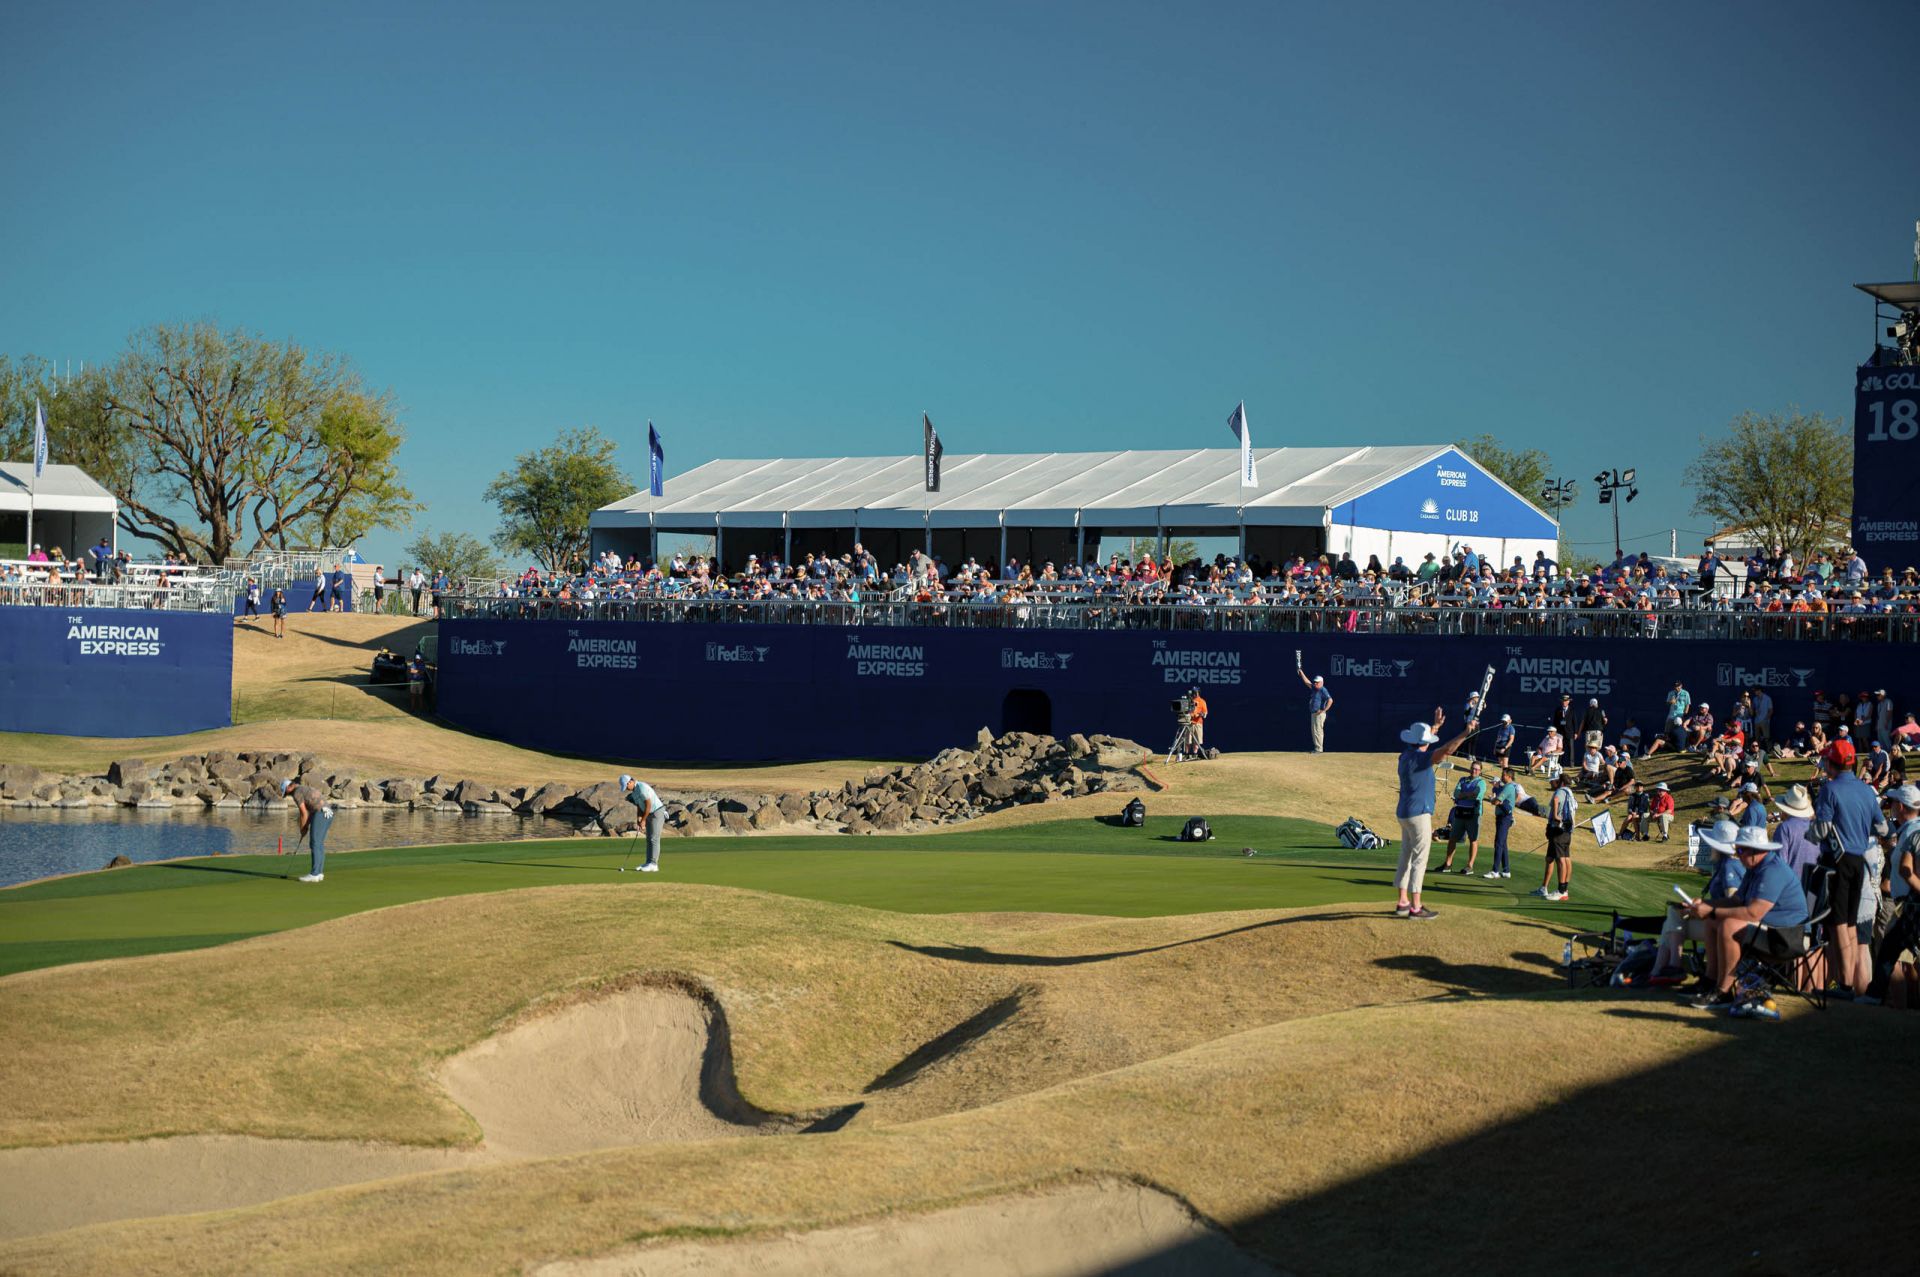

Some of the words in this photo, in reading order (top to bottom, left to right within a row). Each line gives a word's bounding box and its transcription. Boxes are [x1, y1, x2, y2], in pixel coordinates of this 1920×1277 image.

[1868, 399, 1919, 441] 18
[1436, 470, 1466, 480] AMERICAN
[1440, 478, 1466, 488] EXPRESS
[1446, 508, 1468, 521] CLUB
[1469, 510, 1478, 522] 18
[1858, 521, 1918, 531] AMERICAN
[1866, 531, 1919, 541] EXPRESS
[67, 615, 83, 624] THE
[67, 625, 159, 641] AMERICAN
[568, 629, 579, 637] THE
[847, 634, 860, 643] THE
[80, 640, 160, 656] EXPRESS
[460, 639, 493, 655] FedEx
[568, 639, 637, 653] AMERICAN
[847, 644, 924, 661] AMERICAN
[1152, 640, 1167, 649] THE
[1506, 646, 1523, 655] THE
[577, 653, 637, 668] EXPRESS
[717, 645, 754, 662] FedEx
[1014, 651, 1055, 669] FedEx
[1152, 650, 1240, 667] AMERICAN
[857, 660, 924, 677] EXPRESS
[1346, 659, 1393, 678] FedEx
[1505, 658, 1610, 676] AMERICAN
[1163, 667, 1241, 684] EXPRESS
[1734, 667, 1791, 687] FedEx
[1519, 676, 1612, 695] EXPRESS
